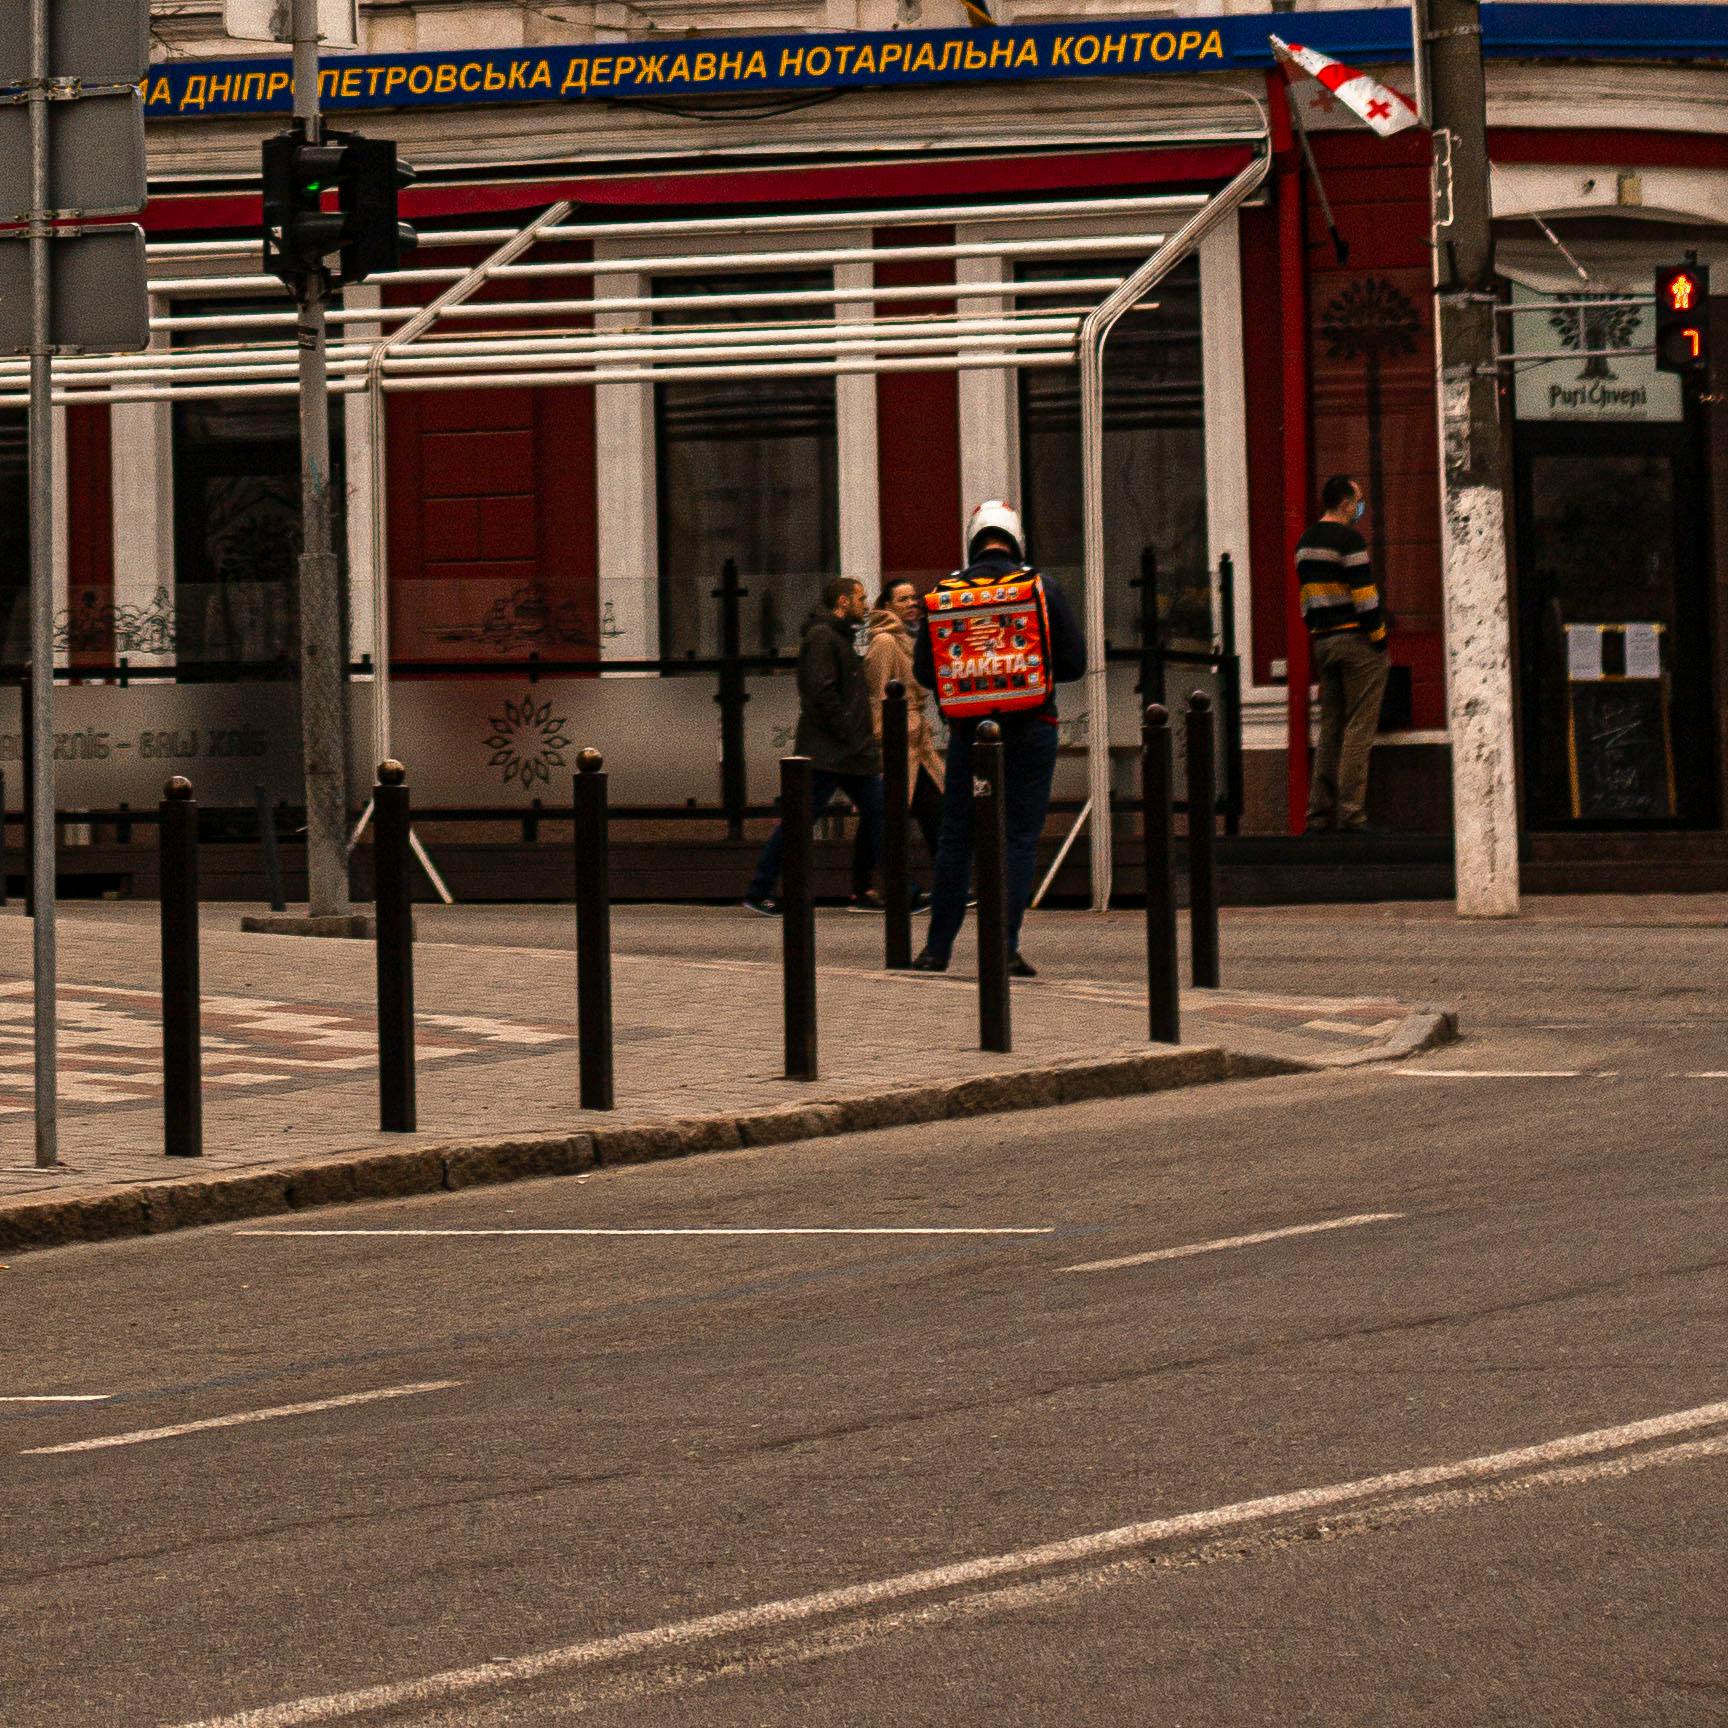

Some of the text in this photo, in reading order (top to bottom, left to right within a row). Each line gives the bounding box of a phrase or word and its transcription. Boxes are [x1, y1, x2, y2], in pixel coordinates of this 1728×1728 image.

[179, 61, 552, 111] ДНІПРПЕТРОВСЬКА
[560, 50, 768, 94] ДЕРЖАВНА
[779, 39, 1039, 77] НОТАРІАЛЬНА
[1051, 30, 1224, 65] КОНТОРА
[952, 653, 1028, 679] RAKETA
